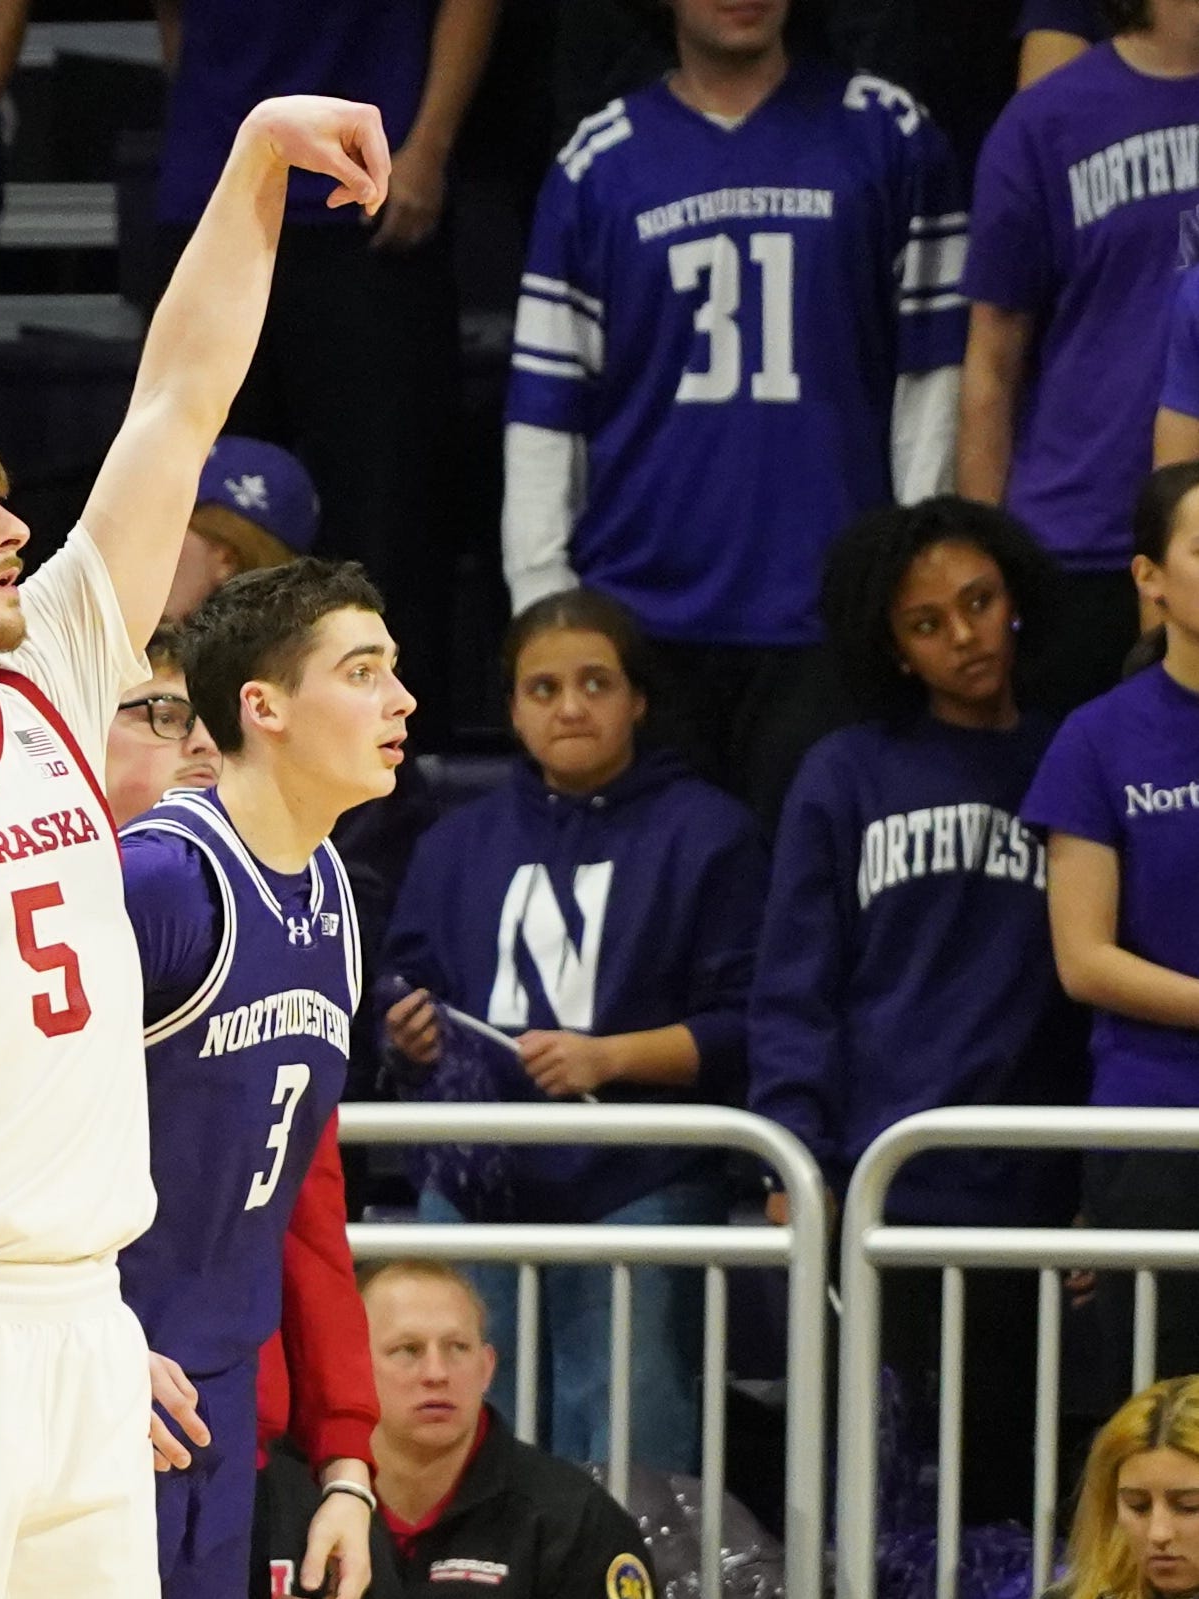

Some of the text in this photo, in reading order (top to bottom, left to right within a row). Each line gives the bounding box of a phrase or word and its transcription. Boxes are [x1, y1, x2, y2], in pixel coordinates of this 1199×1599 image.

[635, 187, 834, 243] NORTHWESTERN
[668, 232, 801, 404] 31
[1124, 780, 1199, 817] Nort
[11, 881, 92, 1038] 5
[487, 860, 615, 1032] N
[198, 988, 350, 1061] NORTHWESTERN
[244, 1063, 311, 1212] 3
